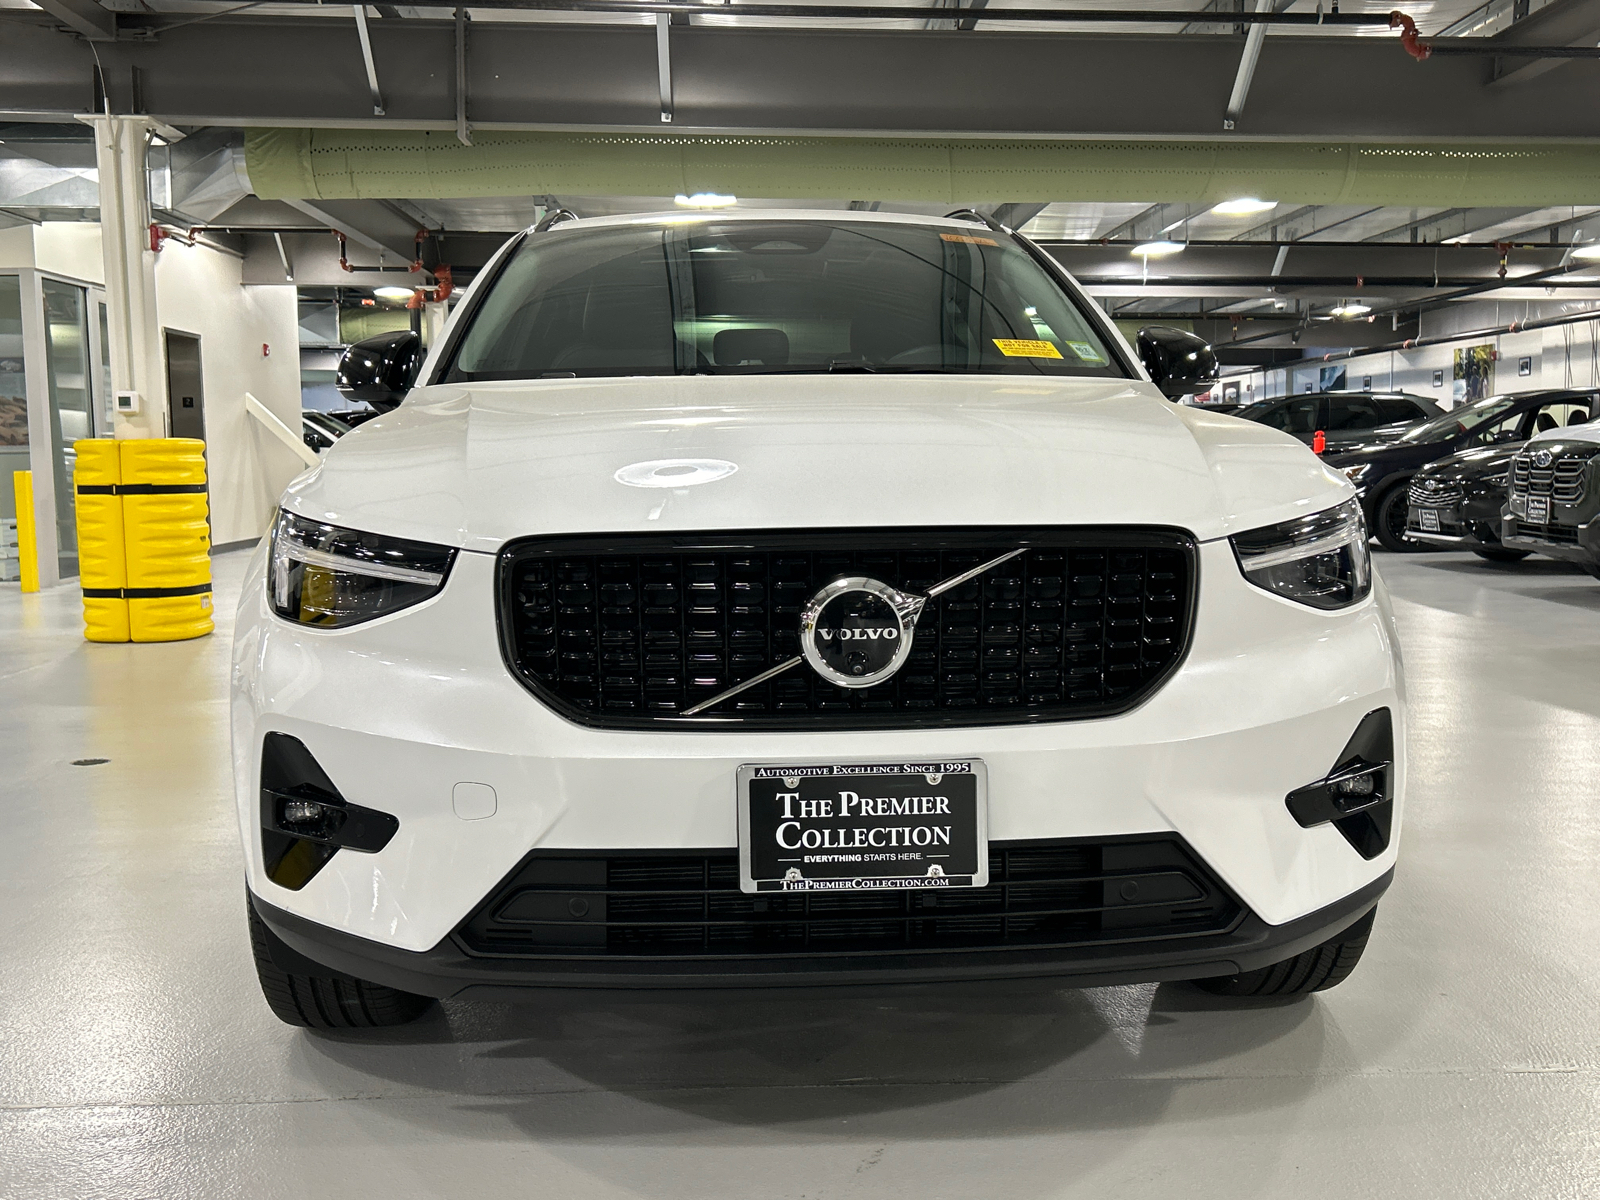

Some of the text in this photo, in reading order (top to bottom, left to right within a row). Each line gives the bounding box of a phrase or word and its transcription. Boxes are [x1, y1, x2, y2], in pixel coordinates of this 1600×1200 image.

[818, 627, 898, 640] VOLVO
[939, 763, 969, 773] 1995
[775, 791, 951, 819] THE PREMIER
[775, 821, 952, 850] COLLECTION
[804, 852, 924, 863] EVERYTHING STARTS HERE.
